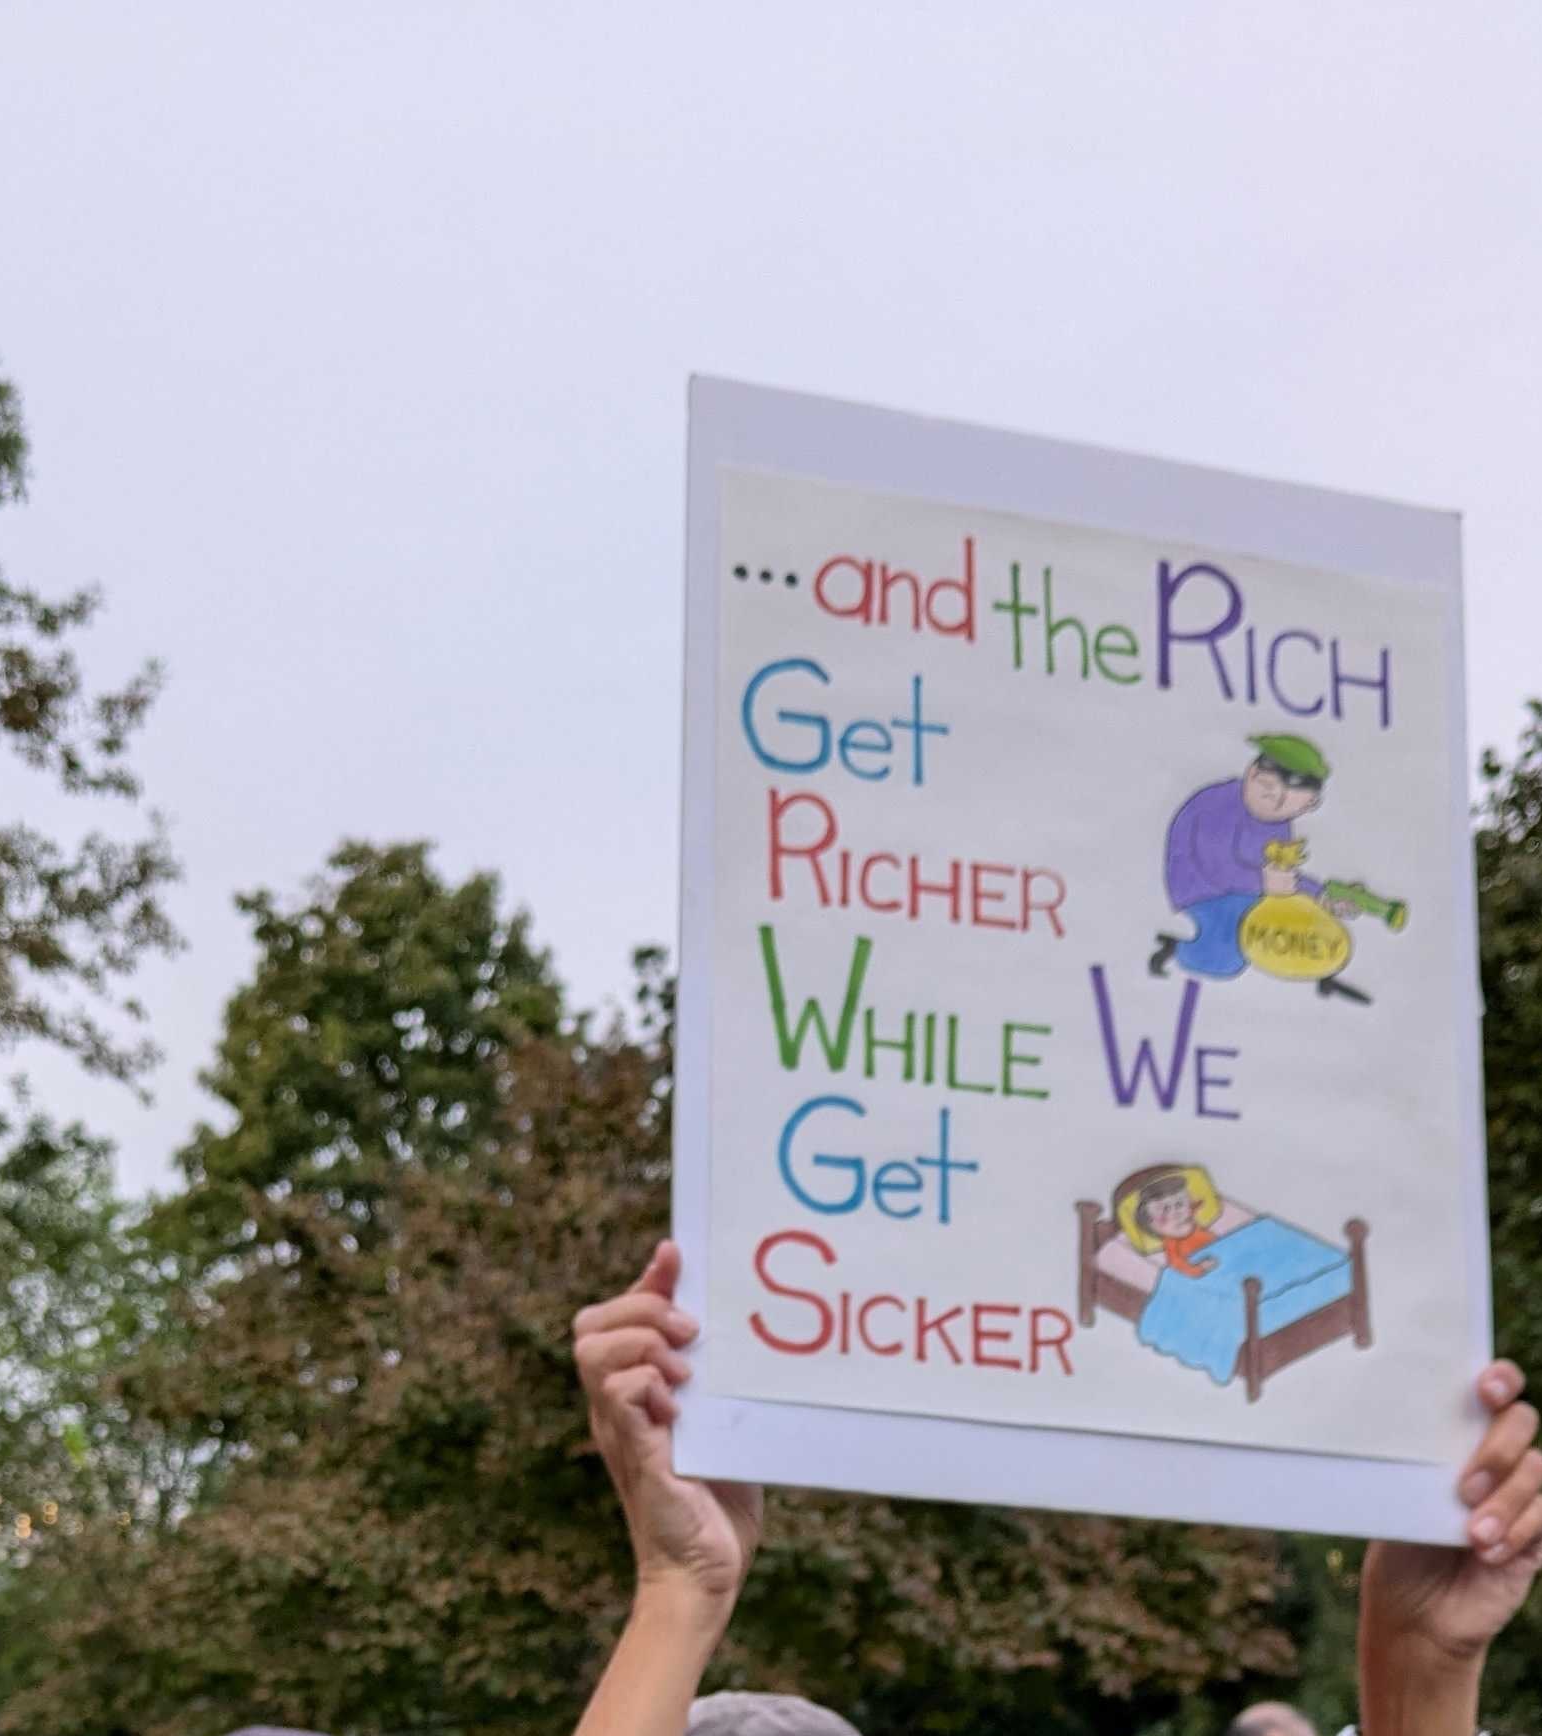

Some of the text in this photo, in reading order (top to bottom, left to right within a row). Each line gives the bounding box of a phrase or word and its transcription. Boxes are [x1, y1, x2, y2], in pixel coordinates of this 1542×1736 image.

[992, 561, 1143, 686] the
[1156, 559, 1393, 729] RICH
[740, 657, 950, 787] Get
[766, 787, 1067, 939] RICHER
[1244, 925, 1345, 959] MONEY
[758, 924, 1242, 1121] WHILE WE
[777, 1094, 980, 1224] Get
[748, 1229, 1076, 1376] SICKER
